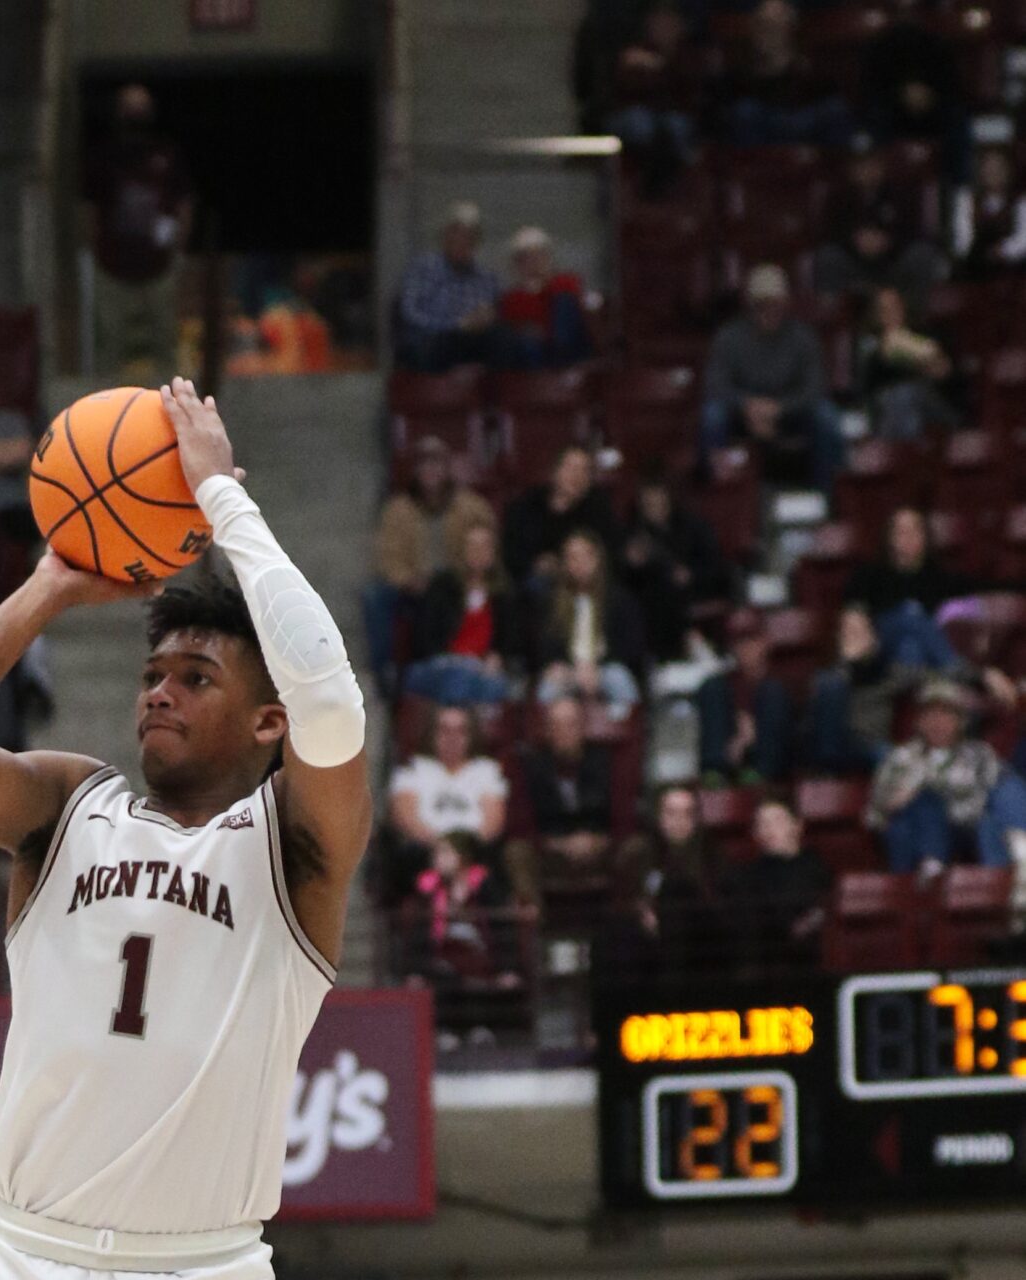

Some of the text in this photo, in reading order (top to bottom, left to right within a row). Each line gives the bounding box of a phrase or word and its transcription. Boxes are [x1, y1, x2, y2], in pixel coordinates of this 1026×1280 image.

[66, 859, 236, 932] MONTANA
[109, 932, 155, 1040] 1
[679, 1083, 784, 1182] 22
